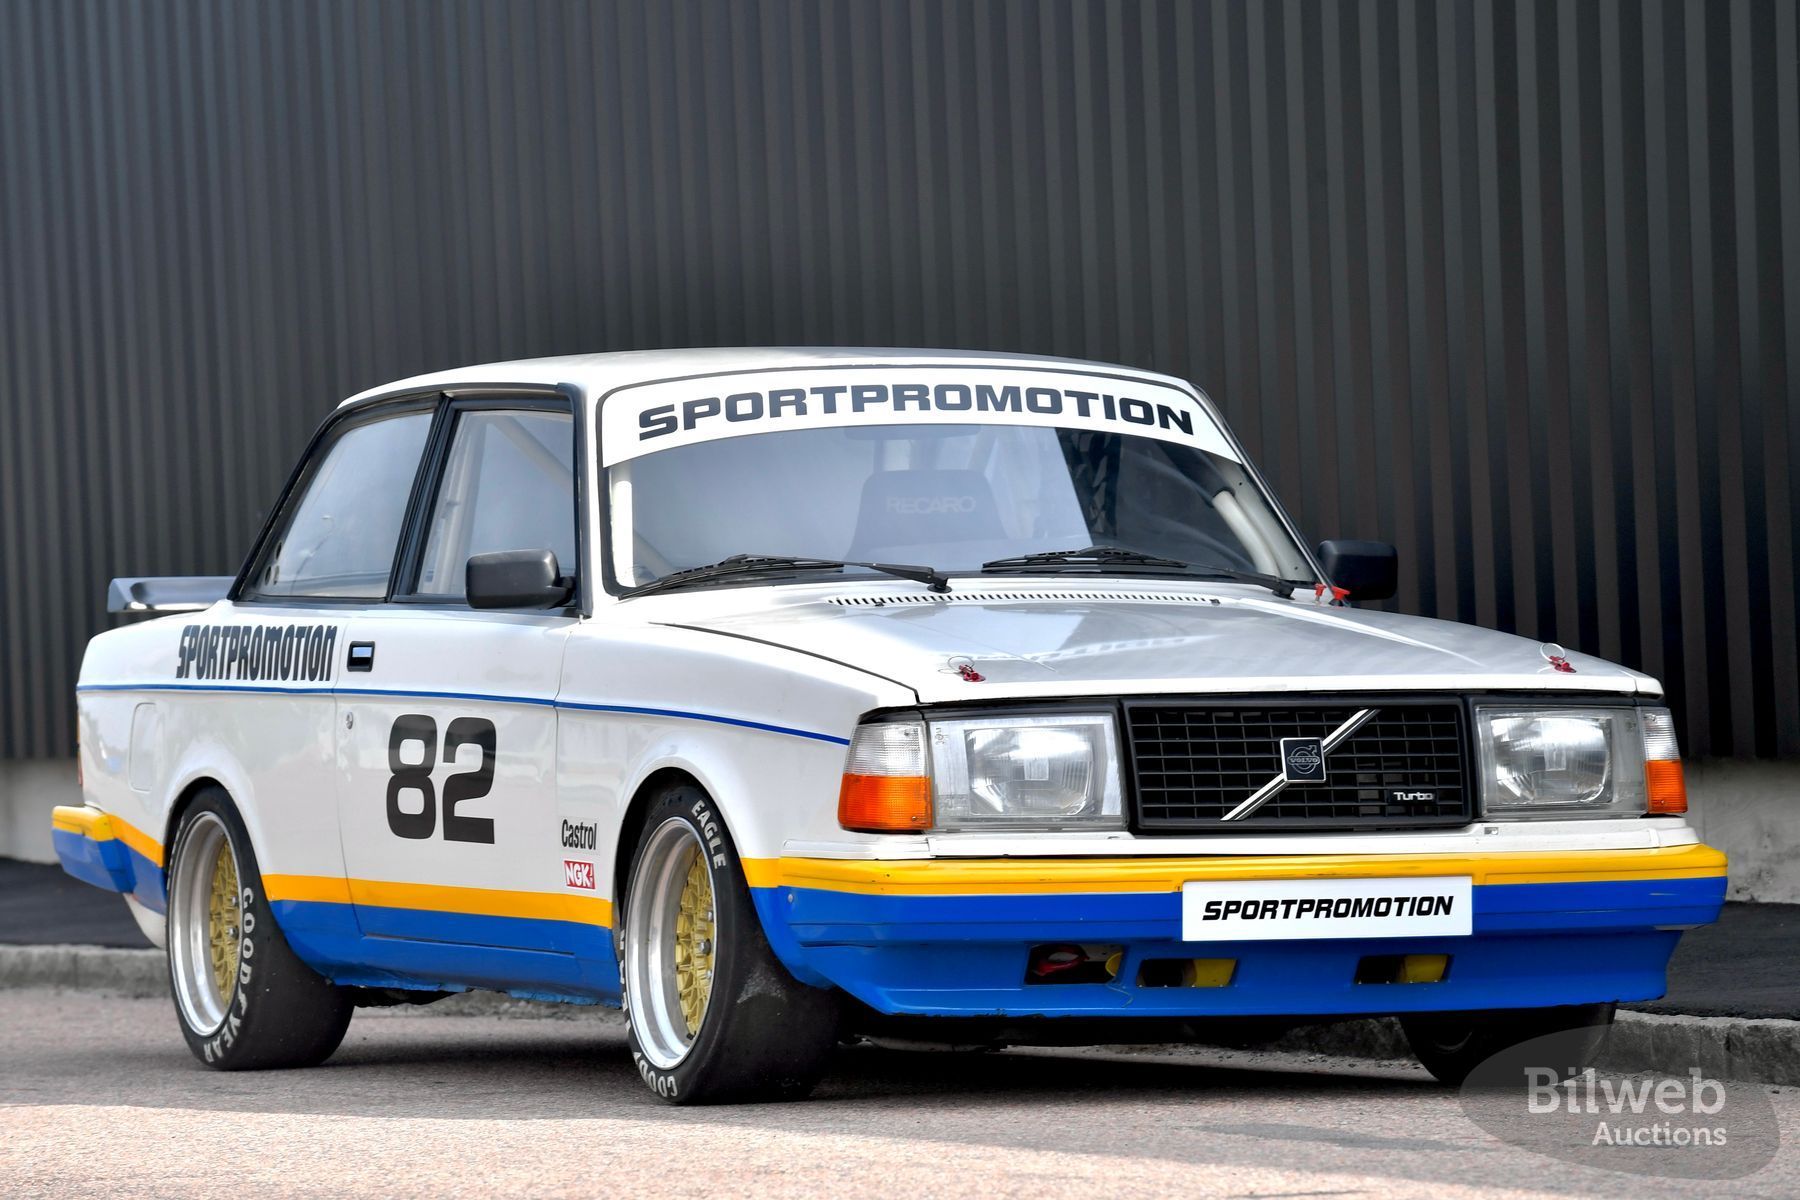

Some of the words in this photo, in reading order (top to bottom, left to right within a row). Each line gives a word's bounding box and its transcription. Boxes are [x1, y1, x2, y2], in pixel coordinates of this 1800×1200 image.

[639, 384, 1194, 442] SPORTPROMOTION
[886, 496, 977, 514] RECARO
[176, 624, 338, 682] SPORTPROMOTION
[386, 714, 497, 844] 82
[1393, 791, 1434, 801] Turbo
[561, 819, 598, 850] Castrol
[691, 799, 727, 869] EAGLE
[564, 862, 592, 887] NGK
[1203, 895, 1454, 922] SPORTPROMOTION
[203, 887, 255, 1062] GOODYEAR
